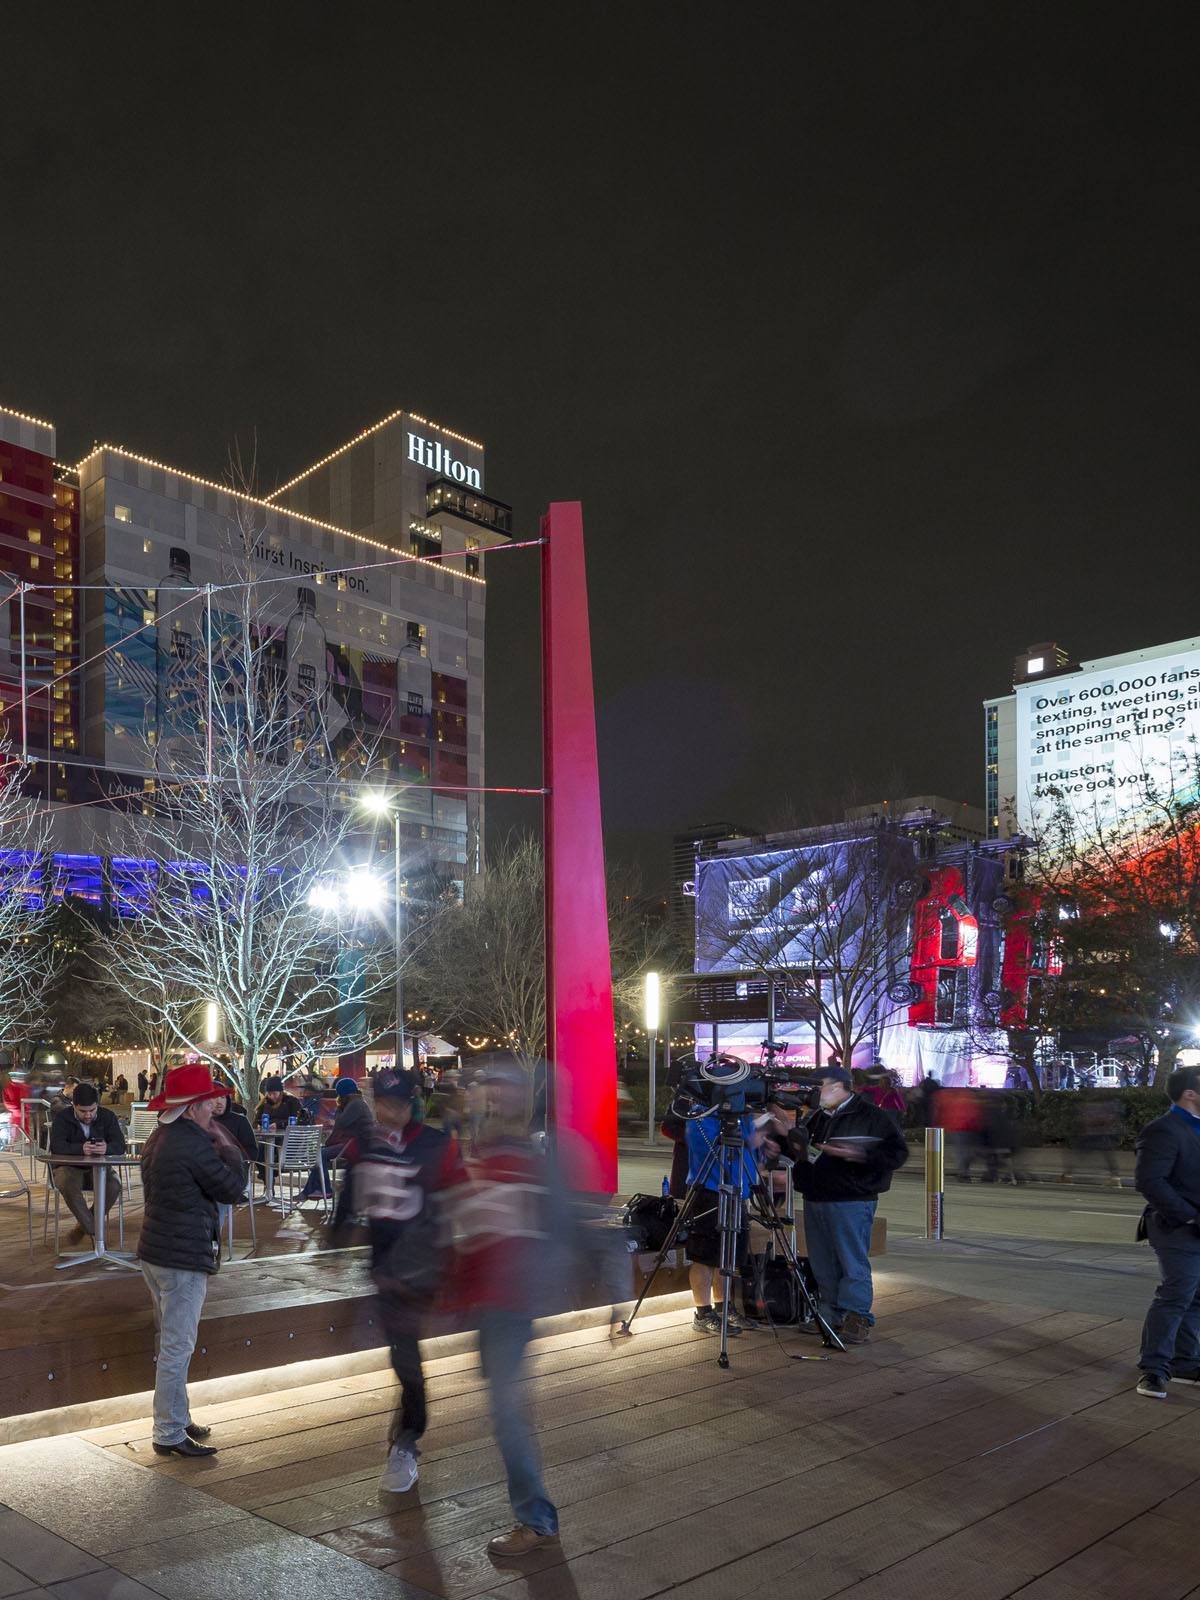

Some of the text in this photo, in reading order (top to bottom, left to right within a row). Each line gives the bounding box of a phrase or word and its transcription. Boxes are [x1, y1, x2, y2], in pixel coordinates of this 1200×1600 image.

[407, 432, 482, 490] Hilton
[1036, 695, 1075, 710] Over
[1079, 675, 1157, 701] 600,000
[1036, 690, 1184, 725] texting, tweeting,
[1036, 698, 1200, 739] snapping and posti
[1036, 716, 1186, 755] at the same time?
[1036, 773, 1154, 798] w've got you.
[1037, 765, 1112, 783] Houston,
